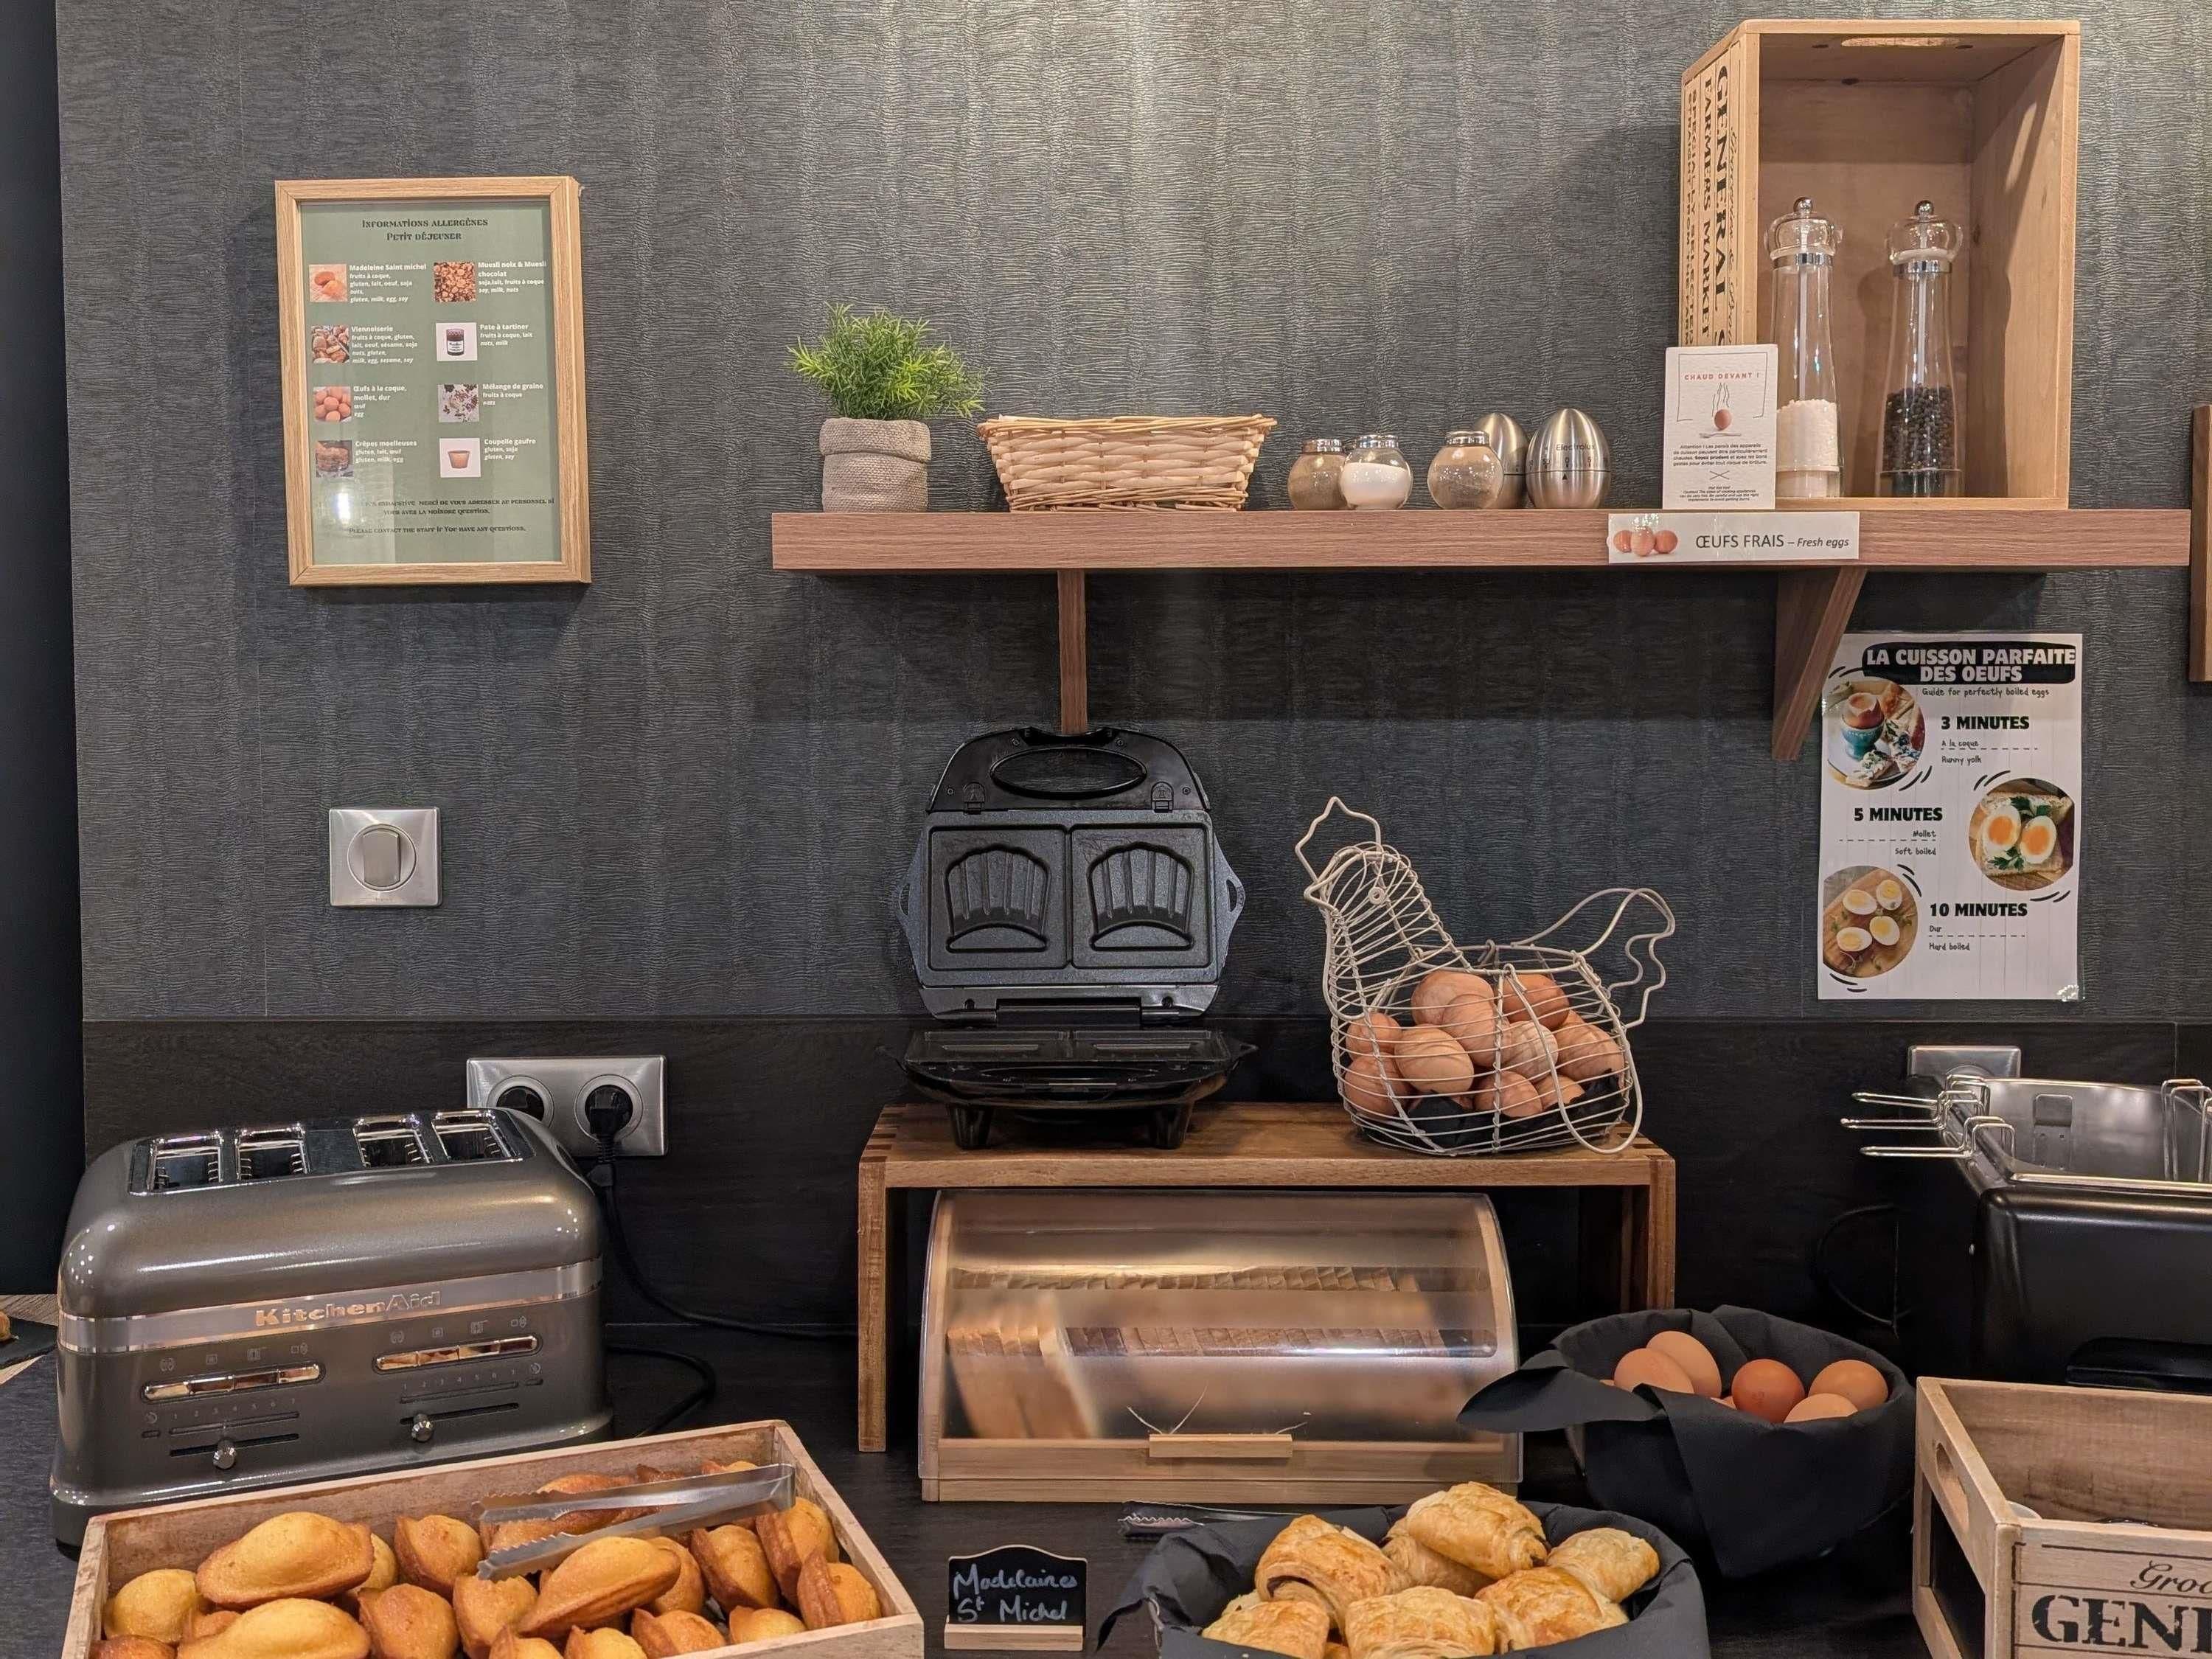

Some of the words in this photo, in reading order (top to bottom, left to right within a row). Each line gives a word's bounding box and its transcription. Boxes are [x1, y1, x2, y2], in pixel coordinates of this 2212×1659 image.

[1716, 66, 1728, 311] GENERAL
[1703, 219, 1711, 337] MARKET
[1696, 535, 1738, 548] ŒUFS
[1744, 535, 1784, 547] FRAIS
[1797, 537, 1823, 547] Fresh
[1826, 538, 1849, 548] eggs
[1867, 650, 1890, 664] LA
[1896, 649, 1976, 665] CUISSON
[1983, 649, 2076, 664] PARFAITE
[1920, 666, 1956, 682] DES
[1961, 666, 2023, 682] OEUFS
[1922, 688, 1945, 696] Guide
[1964, 687, 2003, 698] perfectly
[2006, 688, 2028, 696] boiled
[2031, 689, 2050, 698] eggs
[1941, 717, 1950, 729] 3
[1957, 716, 2029, 729] MINUTES
[1958, 740, 1979, 750] coque
[1941, 756, 1964, 765] Runny
[1967, 755, 1982, 765] yolk
[1854, 808, 1863, 821] 5
[1870, 807, 1943, 821] MINUTES
[1930, 903, 1950, 917] 10
[1955, 903, 2028, 917] MINUTES
[255, 1290, 440, 1326] KitchenAid
[957, 1596, 985, 1622] St
